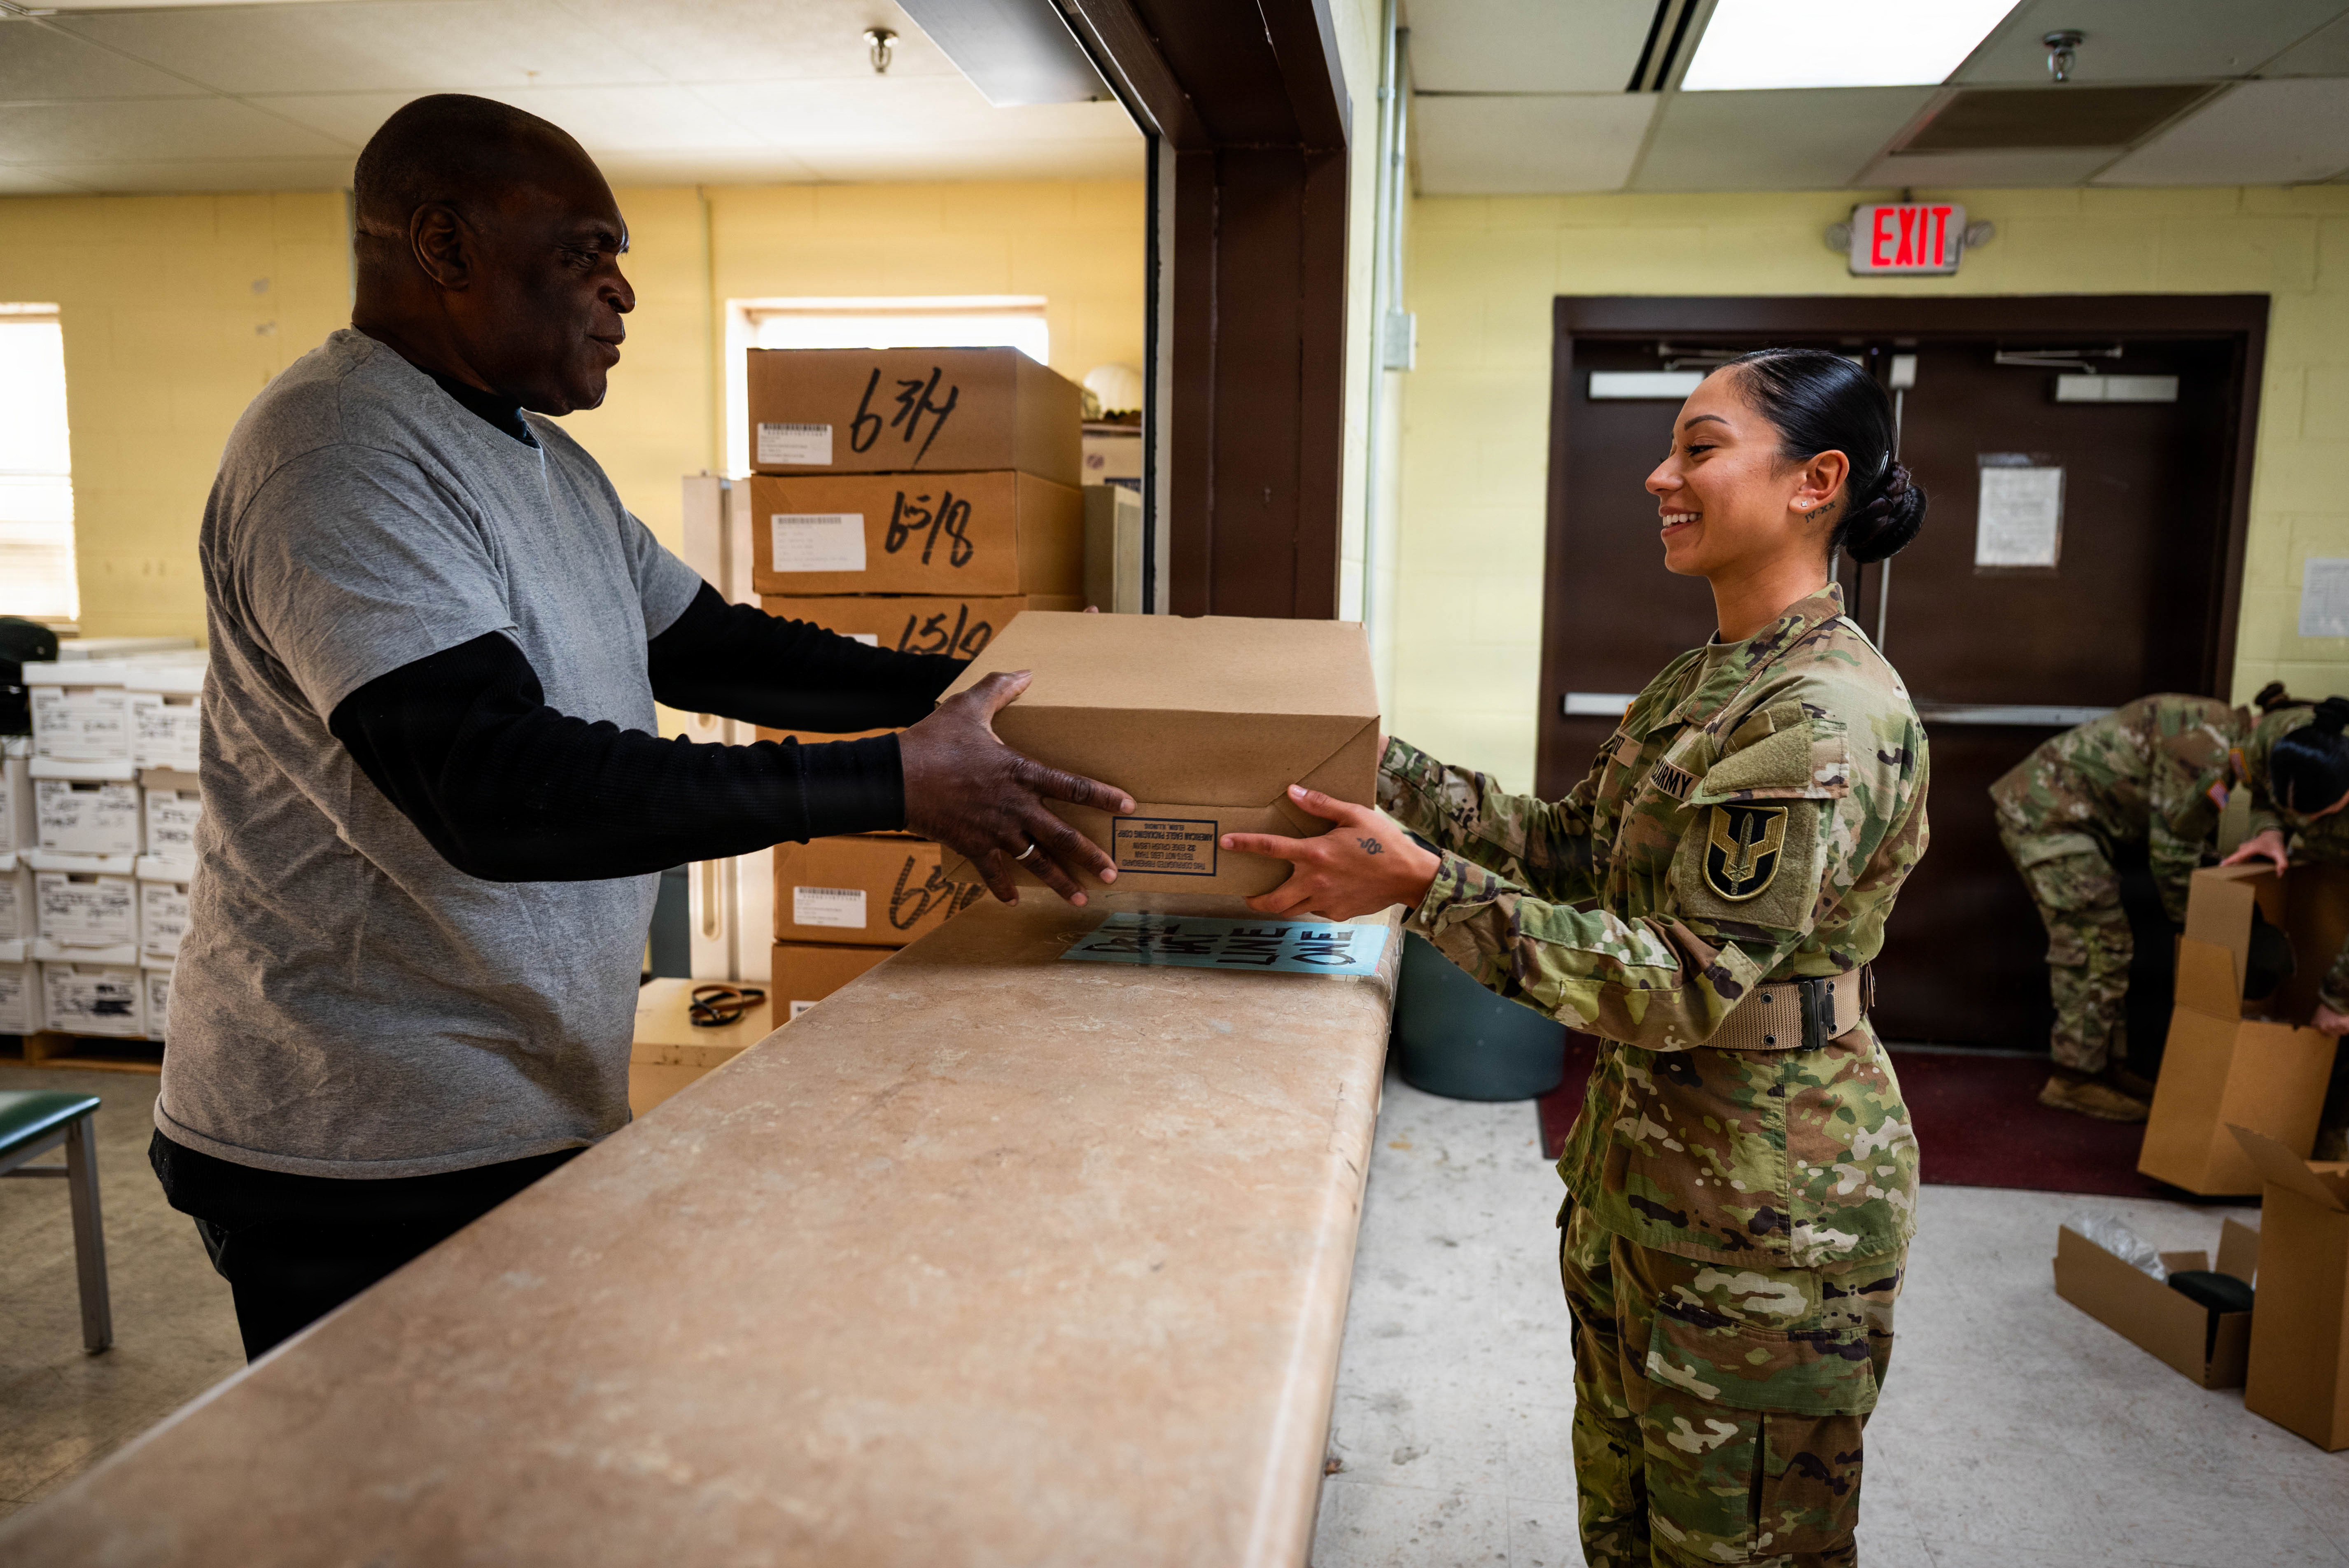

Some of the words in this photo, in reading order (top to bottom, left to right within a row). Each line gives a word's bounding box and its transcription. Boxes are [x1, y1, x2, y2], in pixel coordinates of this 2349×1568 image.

[1871, 206, 1952, 267] EXIT
[1655, 763, 1694, 798] ARMY
[1134, 830, 1165, 840] PACKAGING
[1166, 832, 1183, 840] EAGLE
[1185, 833, 1213, 841] AMERICAN
[1157, 861, 1193, 869] CORRUGATED
[1216, 927, 1294, 966] LINE
[1291, 930, 1357, 966] ONE
